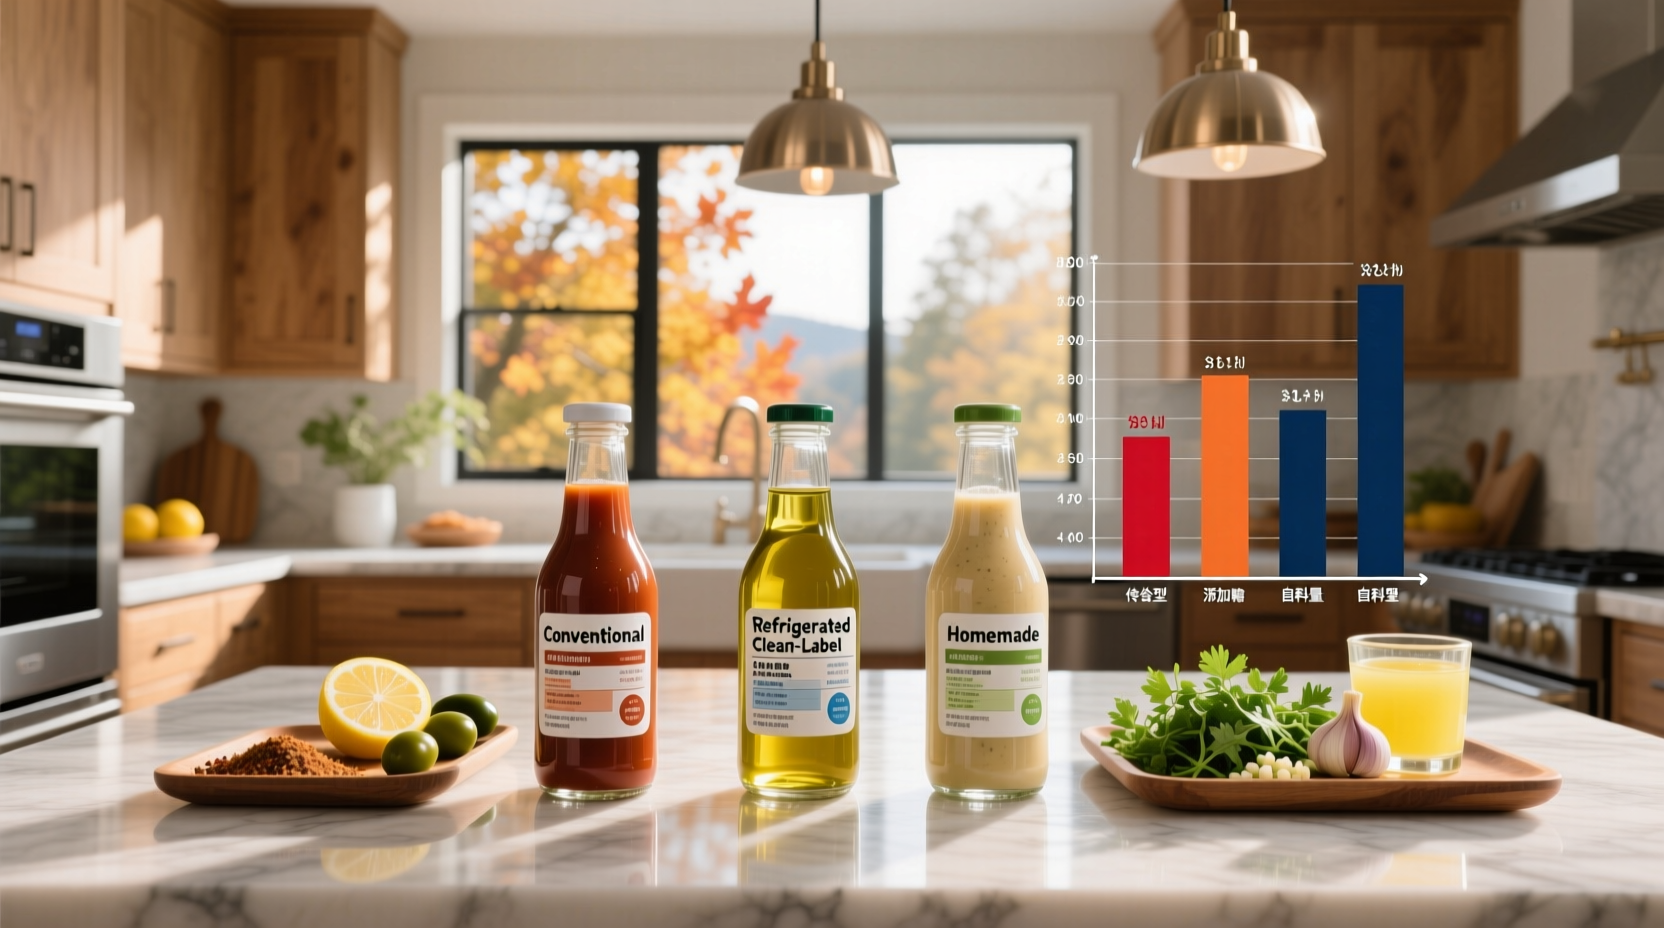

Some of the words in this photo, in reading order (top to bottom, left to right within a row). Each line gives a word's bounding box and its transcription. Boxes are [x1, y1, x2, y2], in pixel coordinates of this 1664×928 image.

[543, 624, 645, 644] Conventional
[752, 616, 851, 638] Refrigerated
[947, 624, 1040, 643] Homemade
[752, 637, 842, 653] Clean-Label
